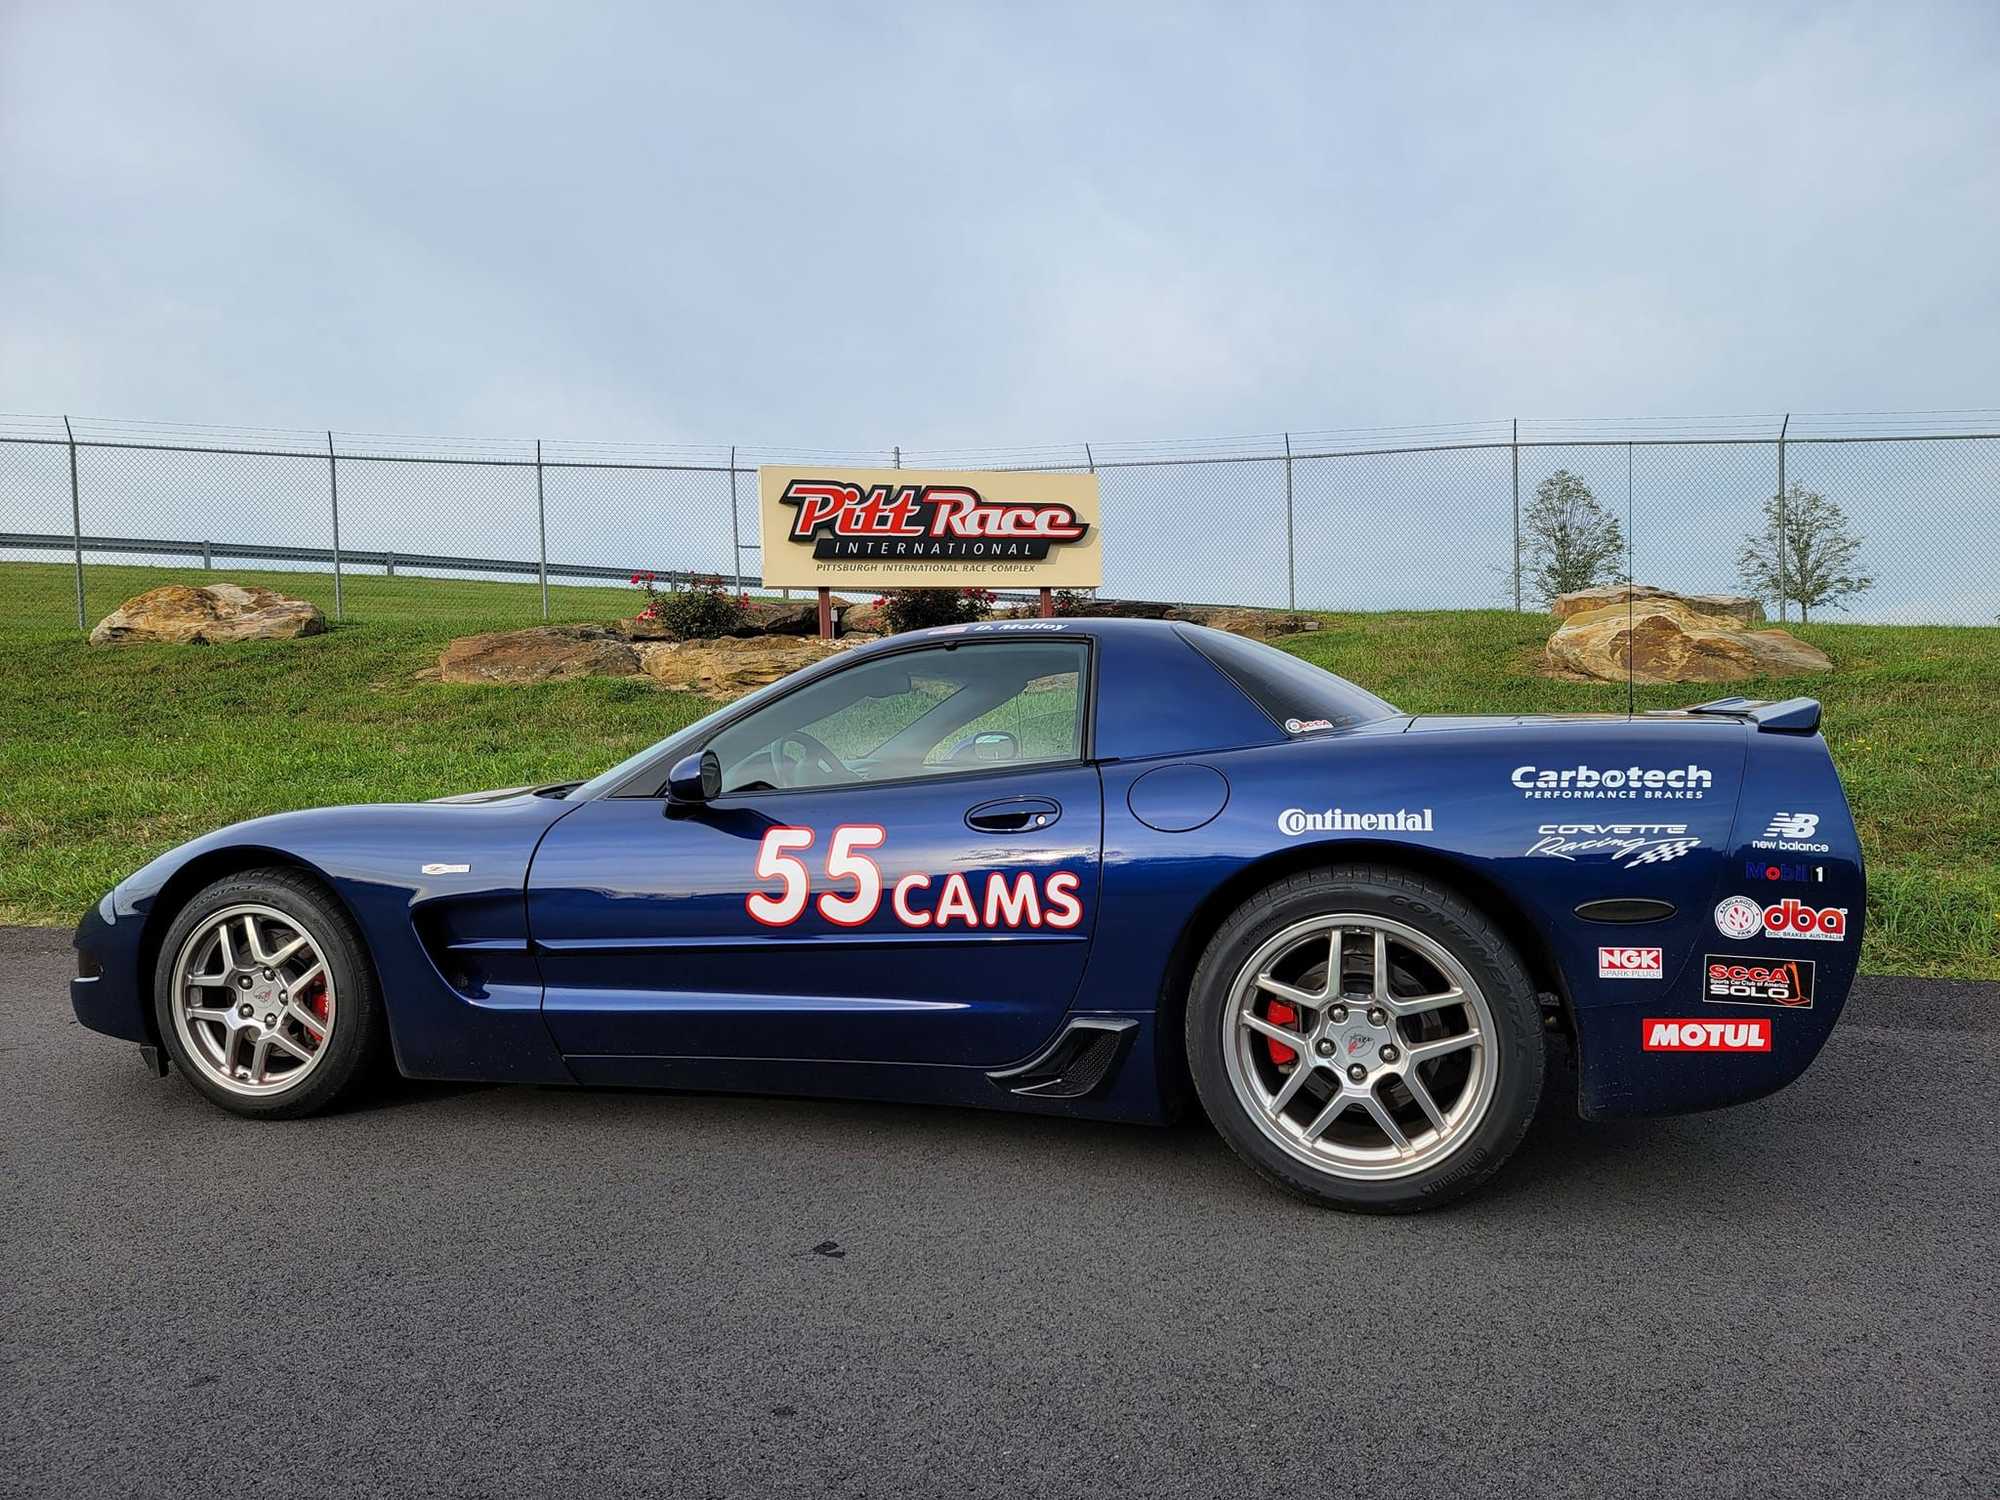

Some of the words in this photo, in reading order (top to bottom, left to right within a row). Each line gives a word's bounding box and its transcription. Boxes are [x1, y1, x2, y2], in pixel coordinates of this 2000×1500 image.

[788, 483, 926, 537] Pitt
[925, 485, 1088, 540] Race
[835, 541, 1033, 556] INTERNATIONAL
[816, 564, 878, 573] PITTSBURGH
[881, 564, 959, 573] INTERNATIONAL
[962, 564, 987, 573] RACE
[991, 564, 1036, 573] COMPLEX
[1511, 765, 1713, 788] Carbotech
[1525, 790, 1637, 800] PERFORMANCE
[1644, 790, 1704, 800] BRAKES
[1277, 808, 1434, 836] Continental
[1538, 824, 1688, 835] CORVETTE
[1525, 836, 1652, 861] Racing
[1752, 840, 1777, 850] new
[1779, 840, 1830, 853] balance
[1745, 862, 1808, 881] Mobil
[1815, 866, 1824, 882] 1
[892, 871, 1085, 929] CAMS
[1763, 898, 1846, 935] dba
[1601, 950, 1659, 969] NGK
[1709, 964, 1790, 984] SCCA
[1710, 984, 1790, 999] SOLO
[1649, 1023, 1766, 1047] MOTUL
